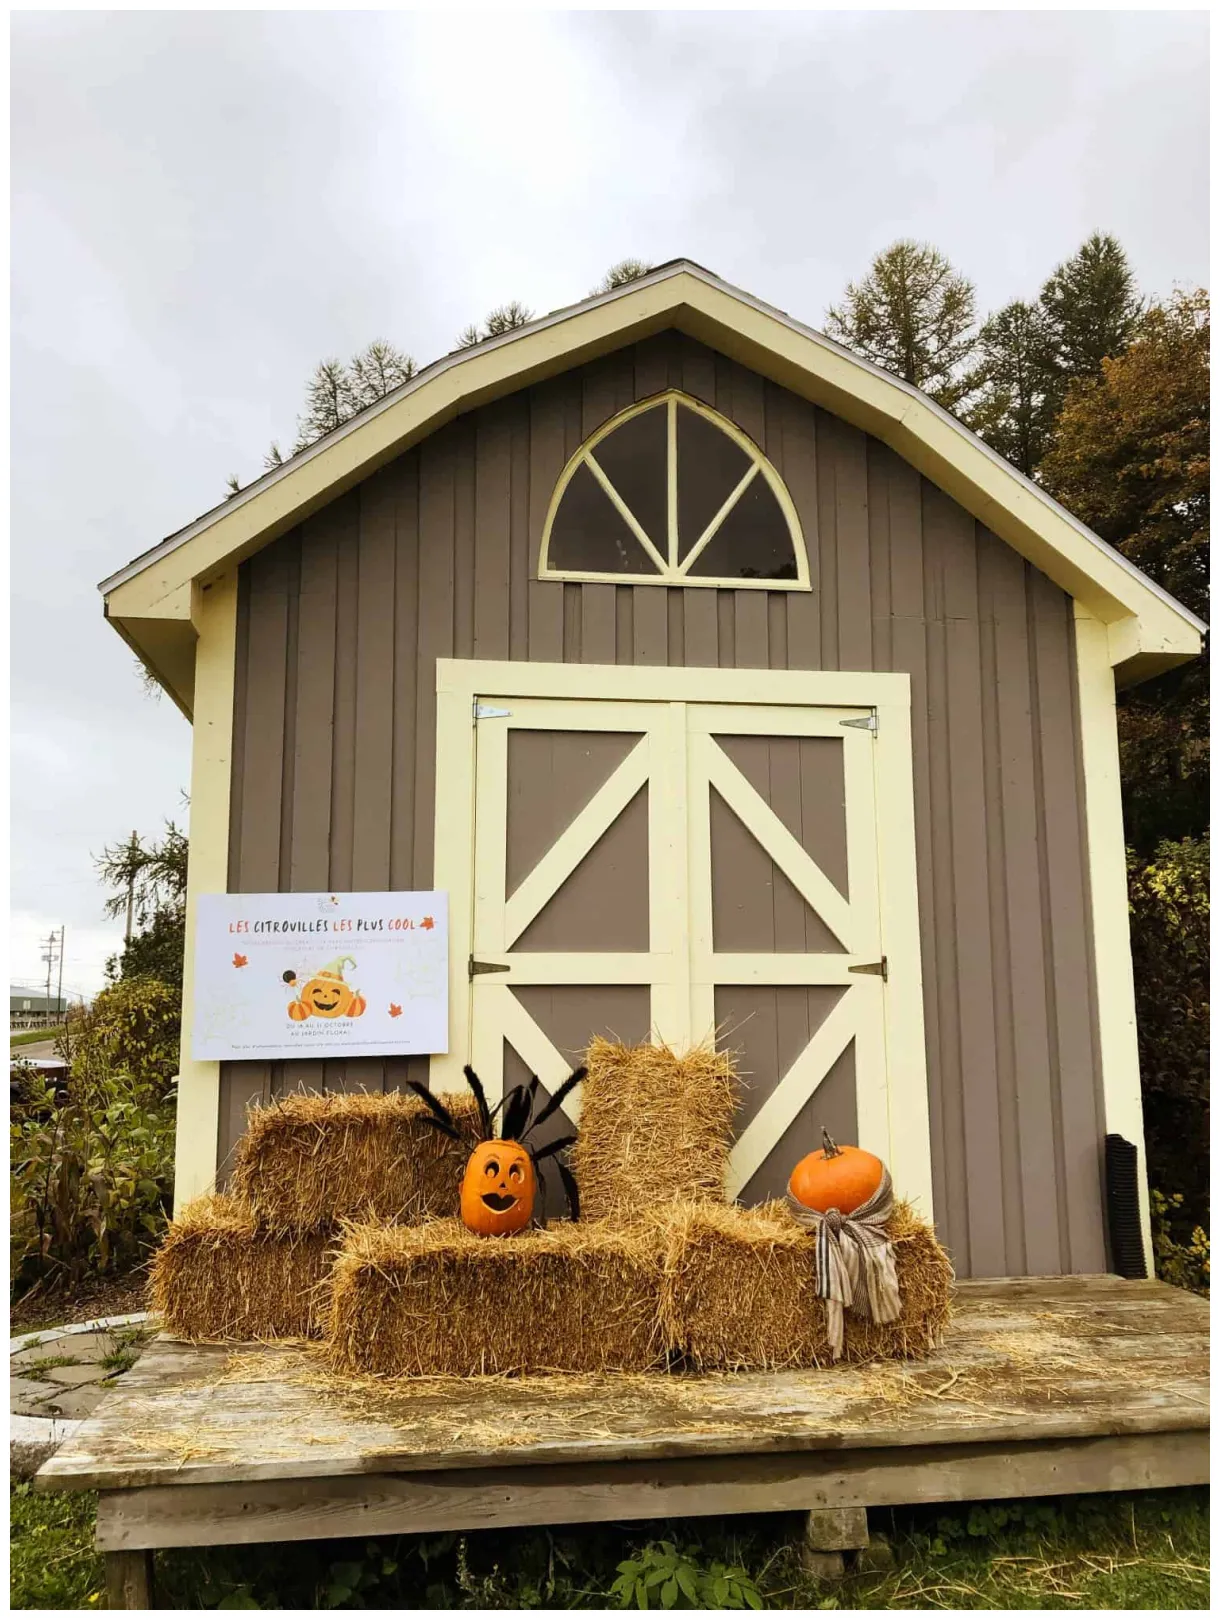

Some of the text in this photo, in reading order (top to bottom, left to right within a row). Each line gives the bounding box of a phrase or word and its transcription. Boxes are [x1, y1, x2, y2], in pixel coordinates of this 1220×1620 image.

[229, 920, 249, 933] LES
[333, 919, 352, 931] LES
[357, 919, 383, 931] PLUS
[388, 918, 416, 930] COOL
